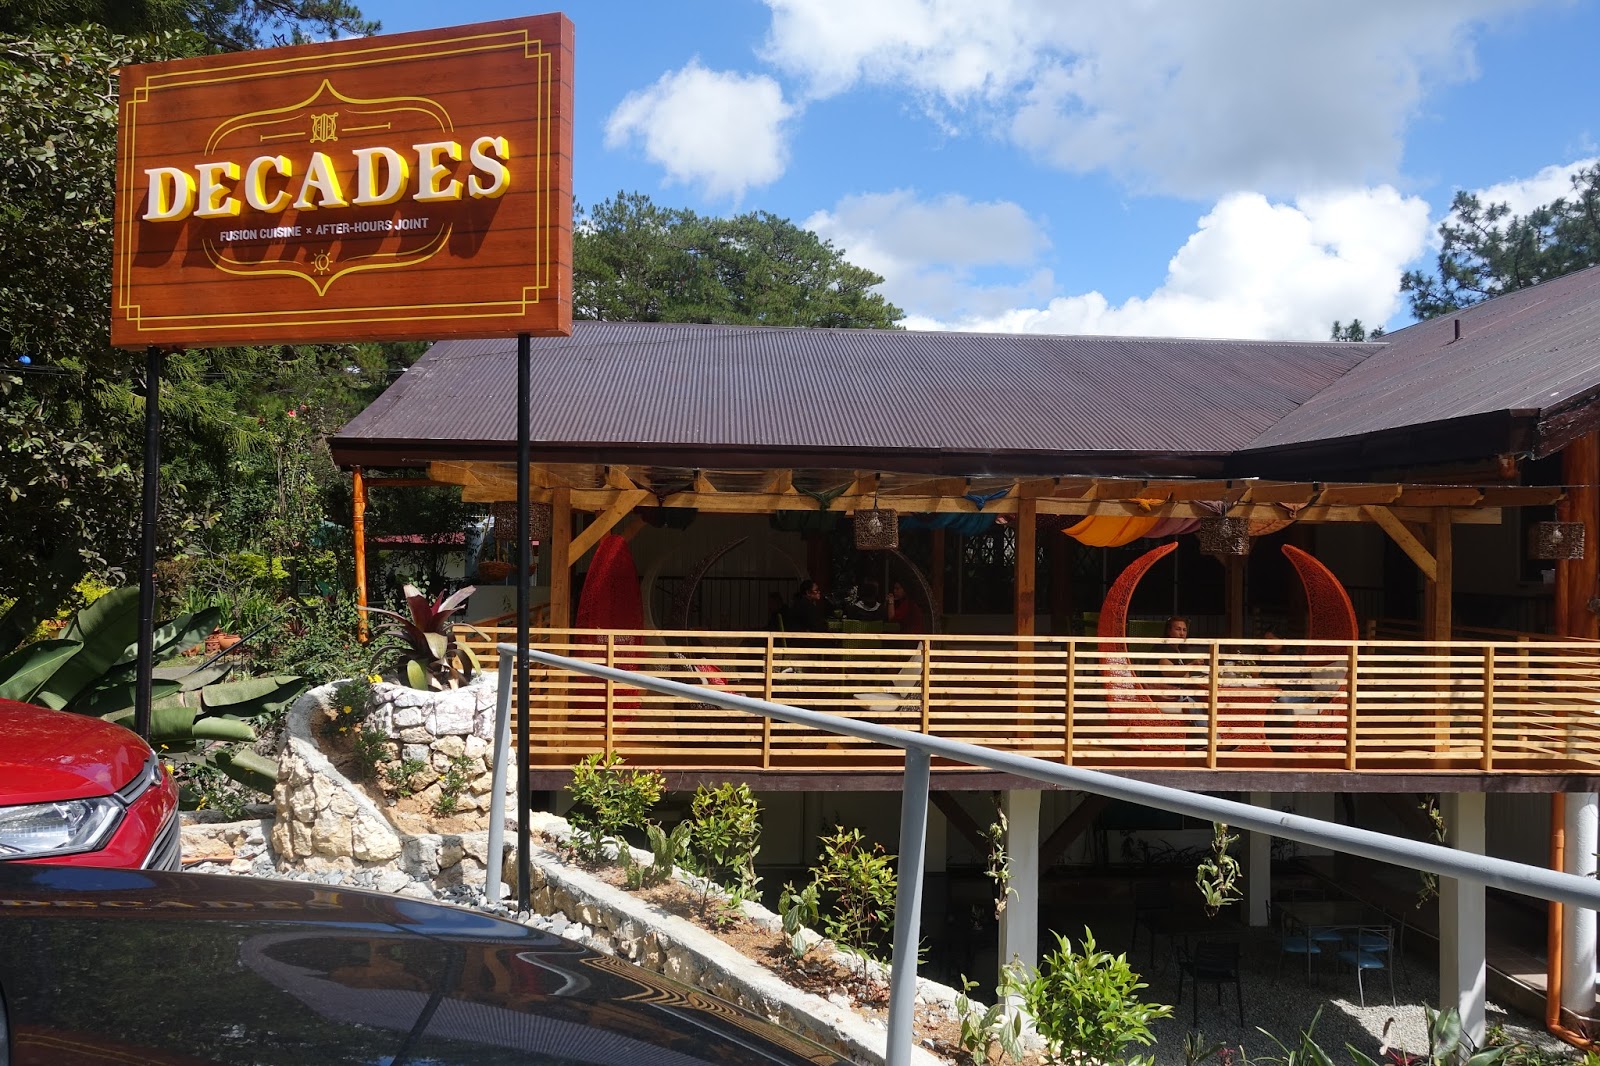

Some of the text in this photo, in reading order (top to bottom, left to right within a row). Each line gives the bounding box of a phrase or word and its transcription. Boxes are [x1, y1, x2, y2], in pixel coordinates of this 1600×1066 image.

[142, 136, 510, 222] DECADES
[219, 230, 258, 242] FUSION
[259, 226, 302, 240] CUISINE
[315, 221, 393, 236] AFTER-HOURS
[394, 218, 429, 231] JOINT
